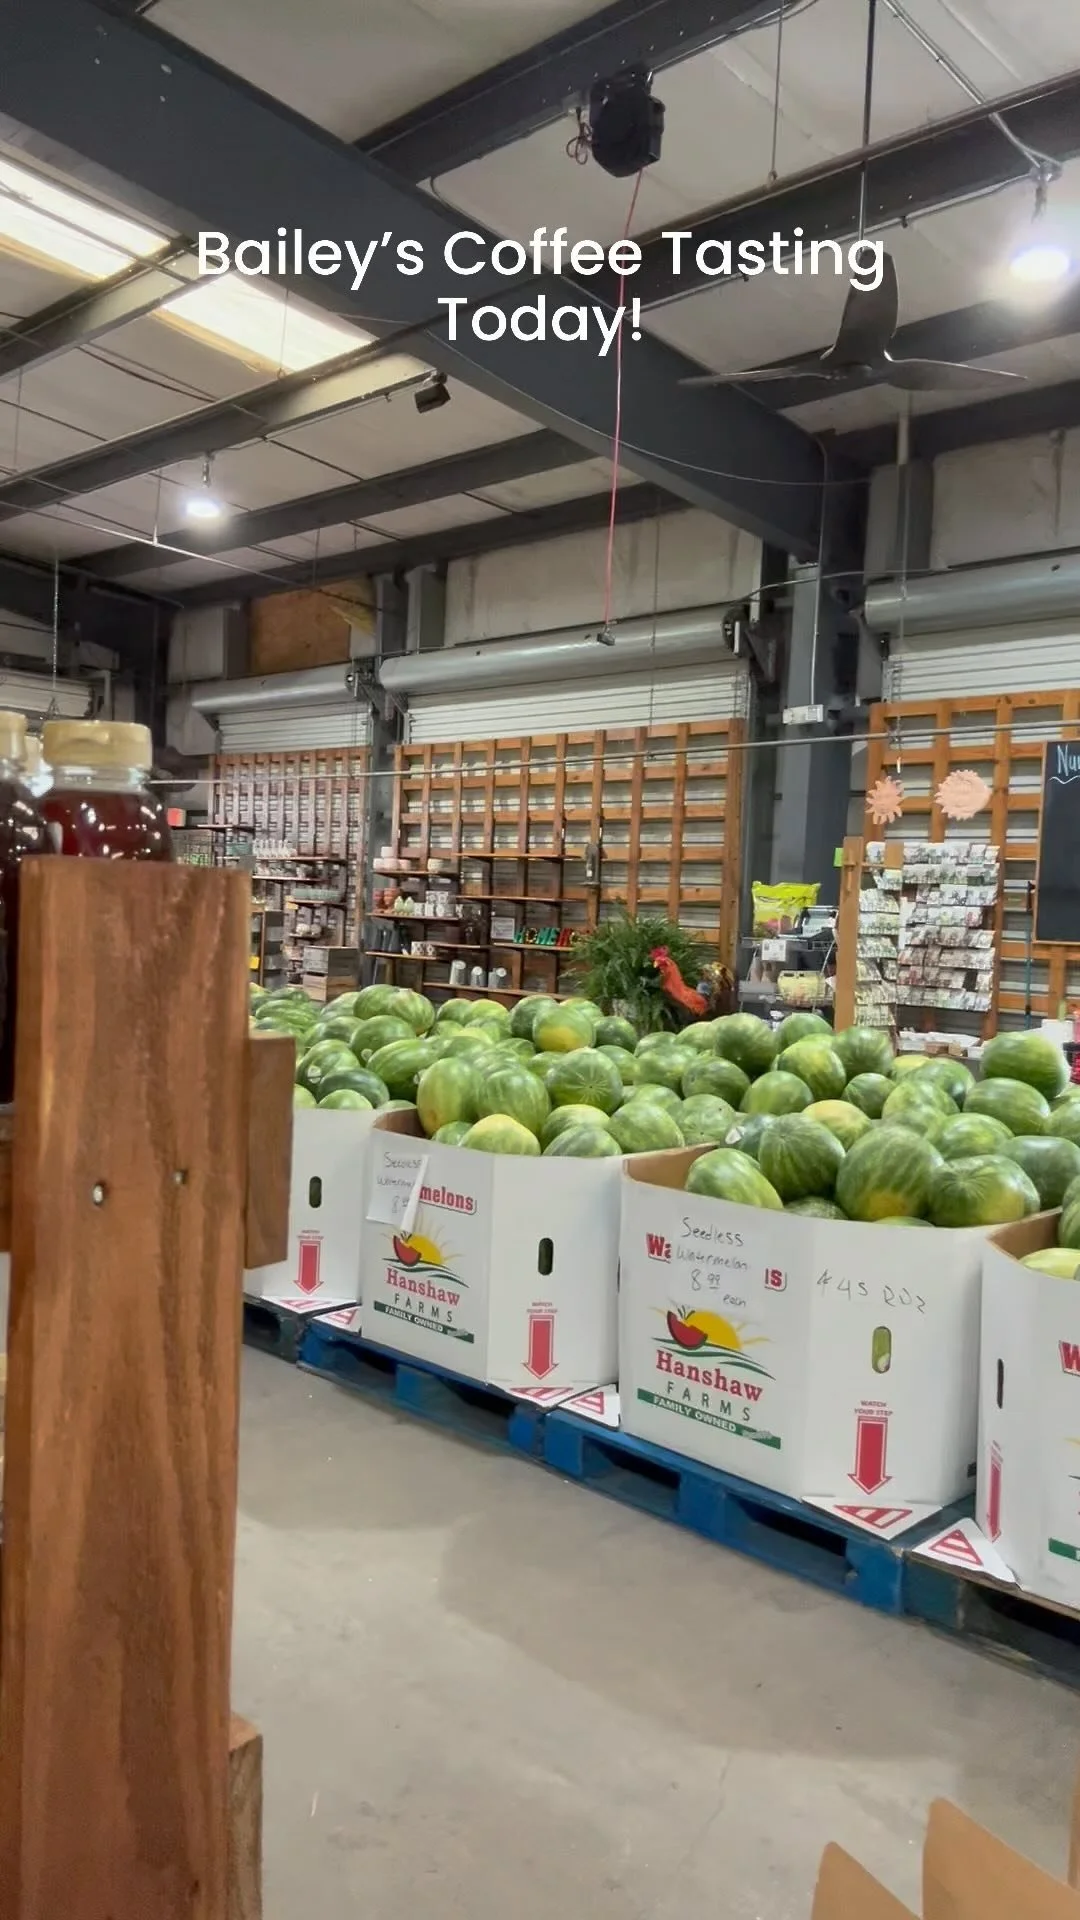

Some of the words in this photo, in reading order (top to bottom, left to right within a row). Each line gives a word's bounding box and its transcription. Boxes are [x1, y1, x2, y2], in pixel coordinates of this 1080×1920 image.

[418, 1185, 474, 1211] melons
[681, 1217, 744, 1247] Seedless
[676, 1246, 748, 1270] Watermelon
[386, 1267, 461, 1306] Hanshaw
[384, 1305, 413, 1321] FAMILY
[414, 1316, 444, 1332] OWNED
[394, 1293, 453, 1323] FARMS
[655, 1349, 763, 1402] Hanshaw
[653, 1395, 692, 1416] FAMILY
[694, 1408, 738, 1433] OWNED
[667, 1381, 751, 1421] FARMS
